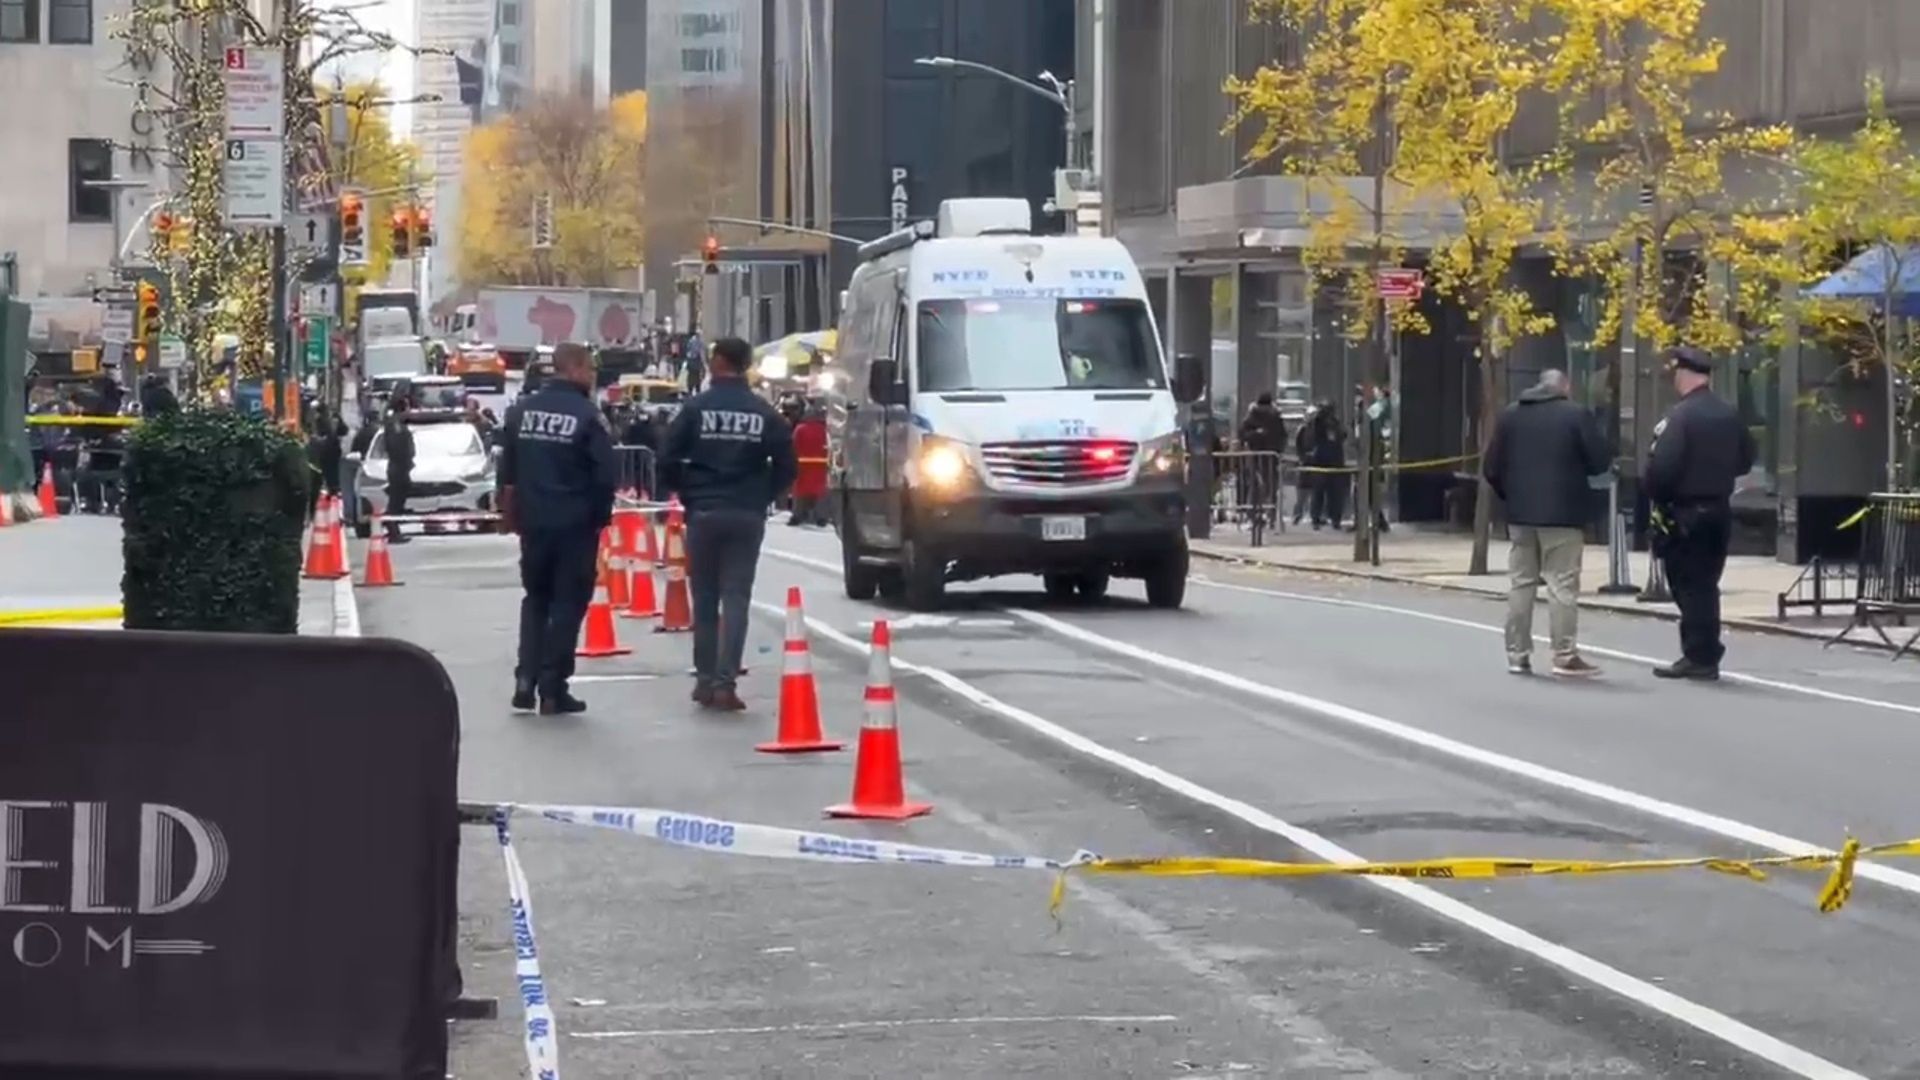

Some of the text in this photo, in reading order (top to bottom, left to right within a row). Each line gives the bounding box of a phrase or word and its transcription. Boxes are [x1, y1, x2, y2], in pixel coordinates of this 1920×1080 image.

[230, 142, 242, 161] 6
[521, 410, 577, 436] NYPD
[702, 411, 763, 435] NYPD
[0, 800, 229, 914] ELD
